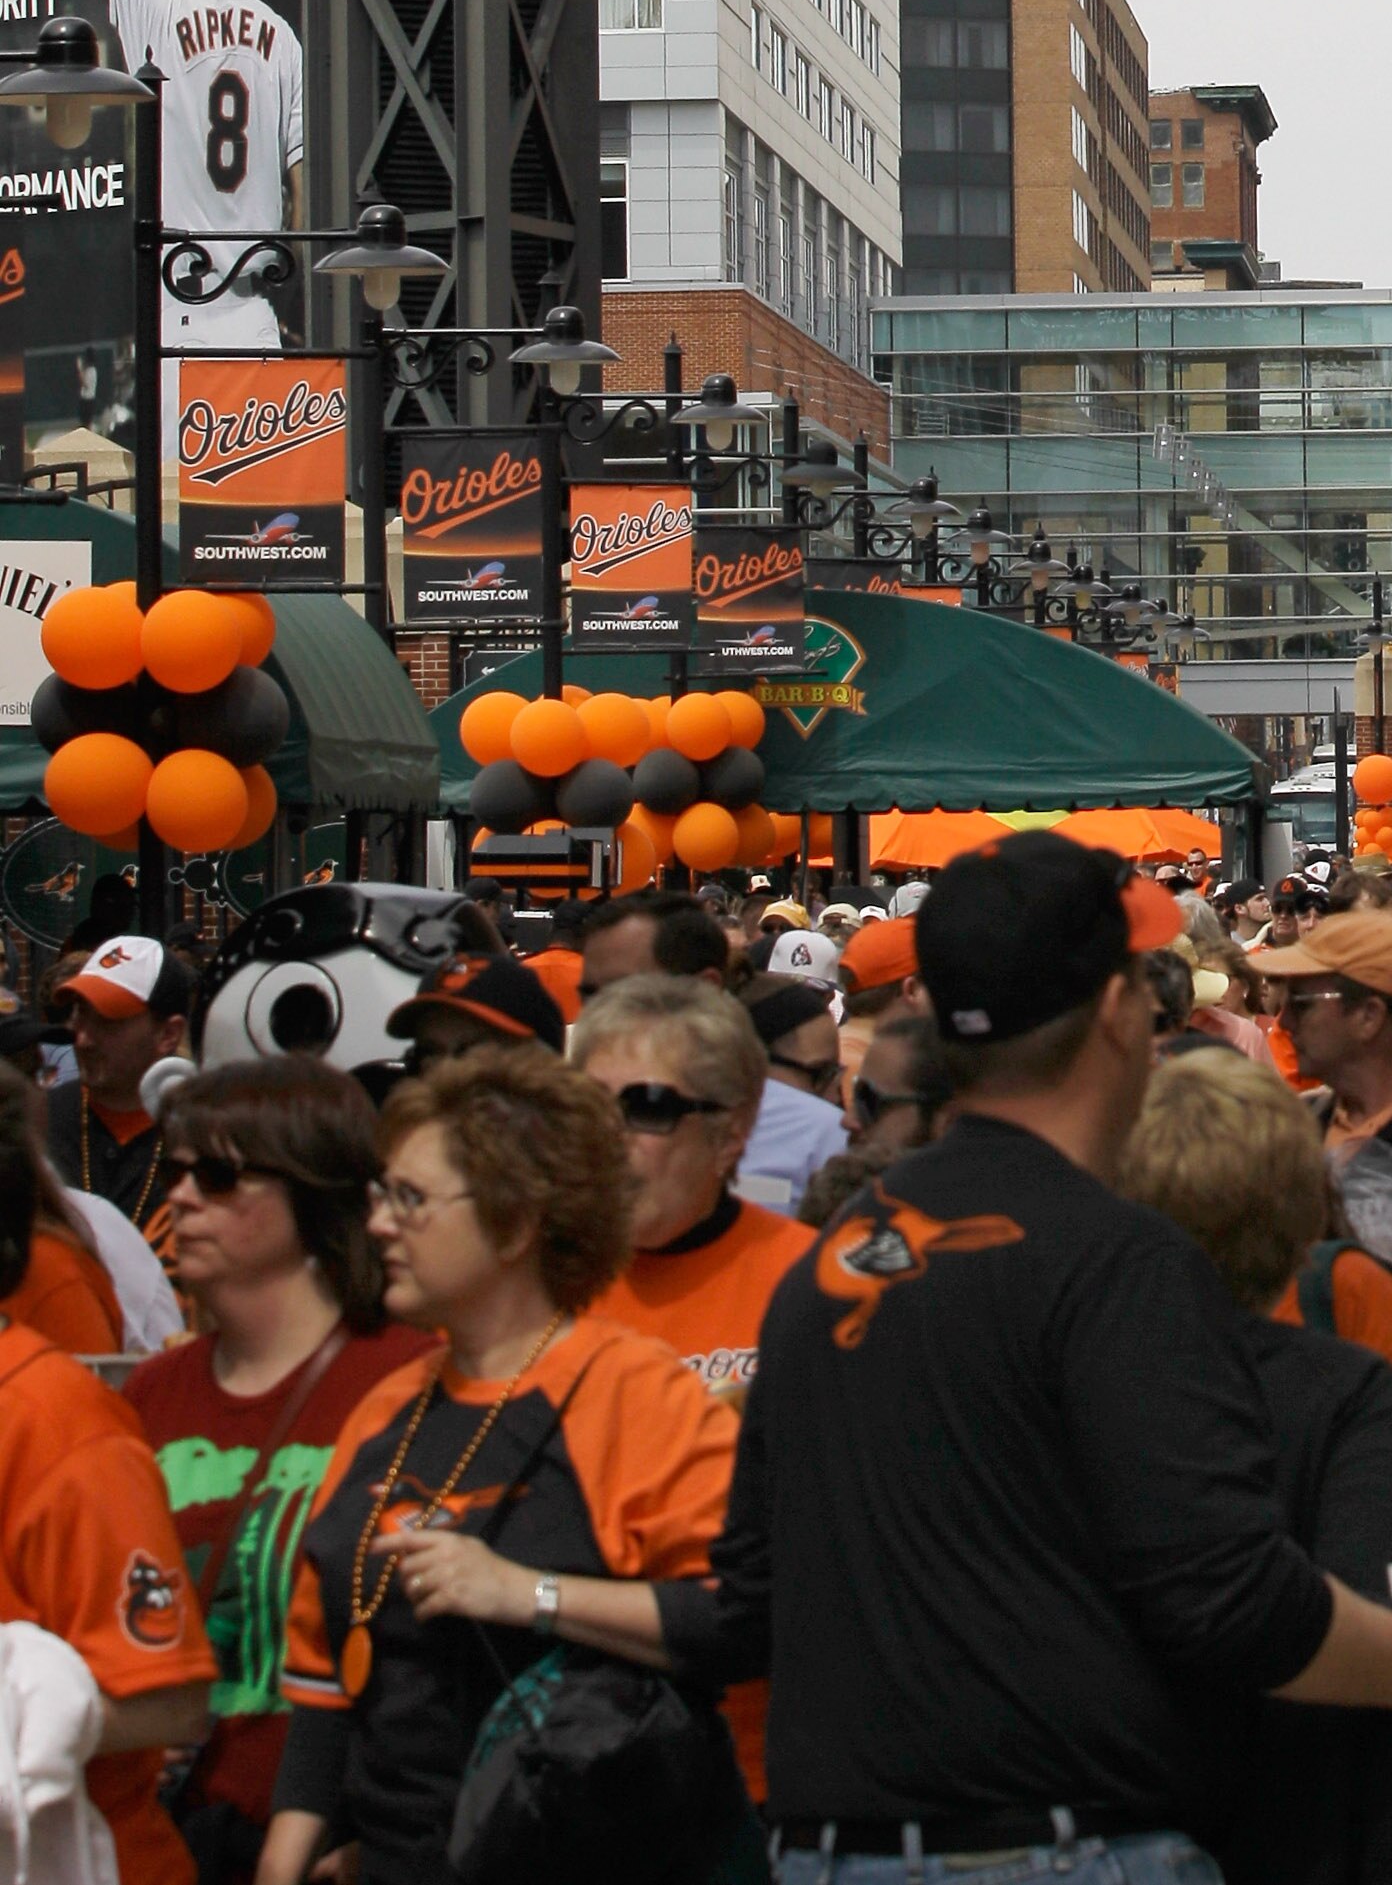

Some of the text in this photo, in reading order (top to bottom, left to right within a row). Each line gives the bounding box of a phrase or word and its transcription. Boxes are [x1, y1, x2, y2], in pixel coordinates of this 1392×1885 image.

[176, 6, 277, 63] RIPKEN
[206, 68, 251, 194] 8
[179, 380, 347, 468] Orioles
[402, 451, 542, 524] Orioles
[193, 546, 328, 561] SOUTHWEST.COM
[571, 501, 693, 563] Orioles
[418, 589, 529, 604] SOUTHWEST.COM
[697, 543, 803, 597] Orioles
[582, 620, 679, 631] SOUTHWEST.COM
